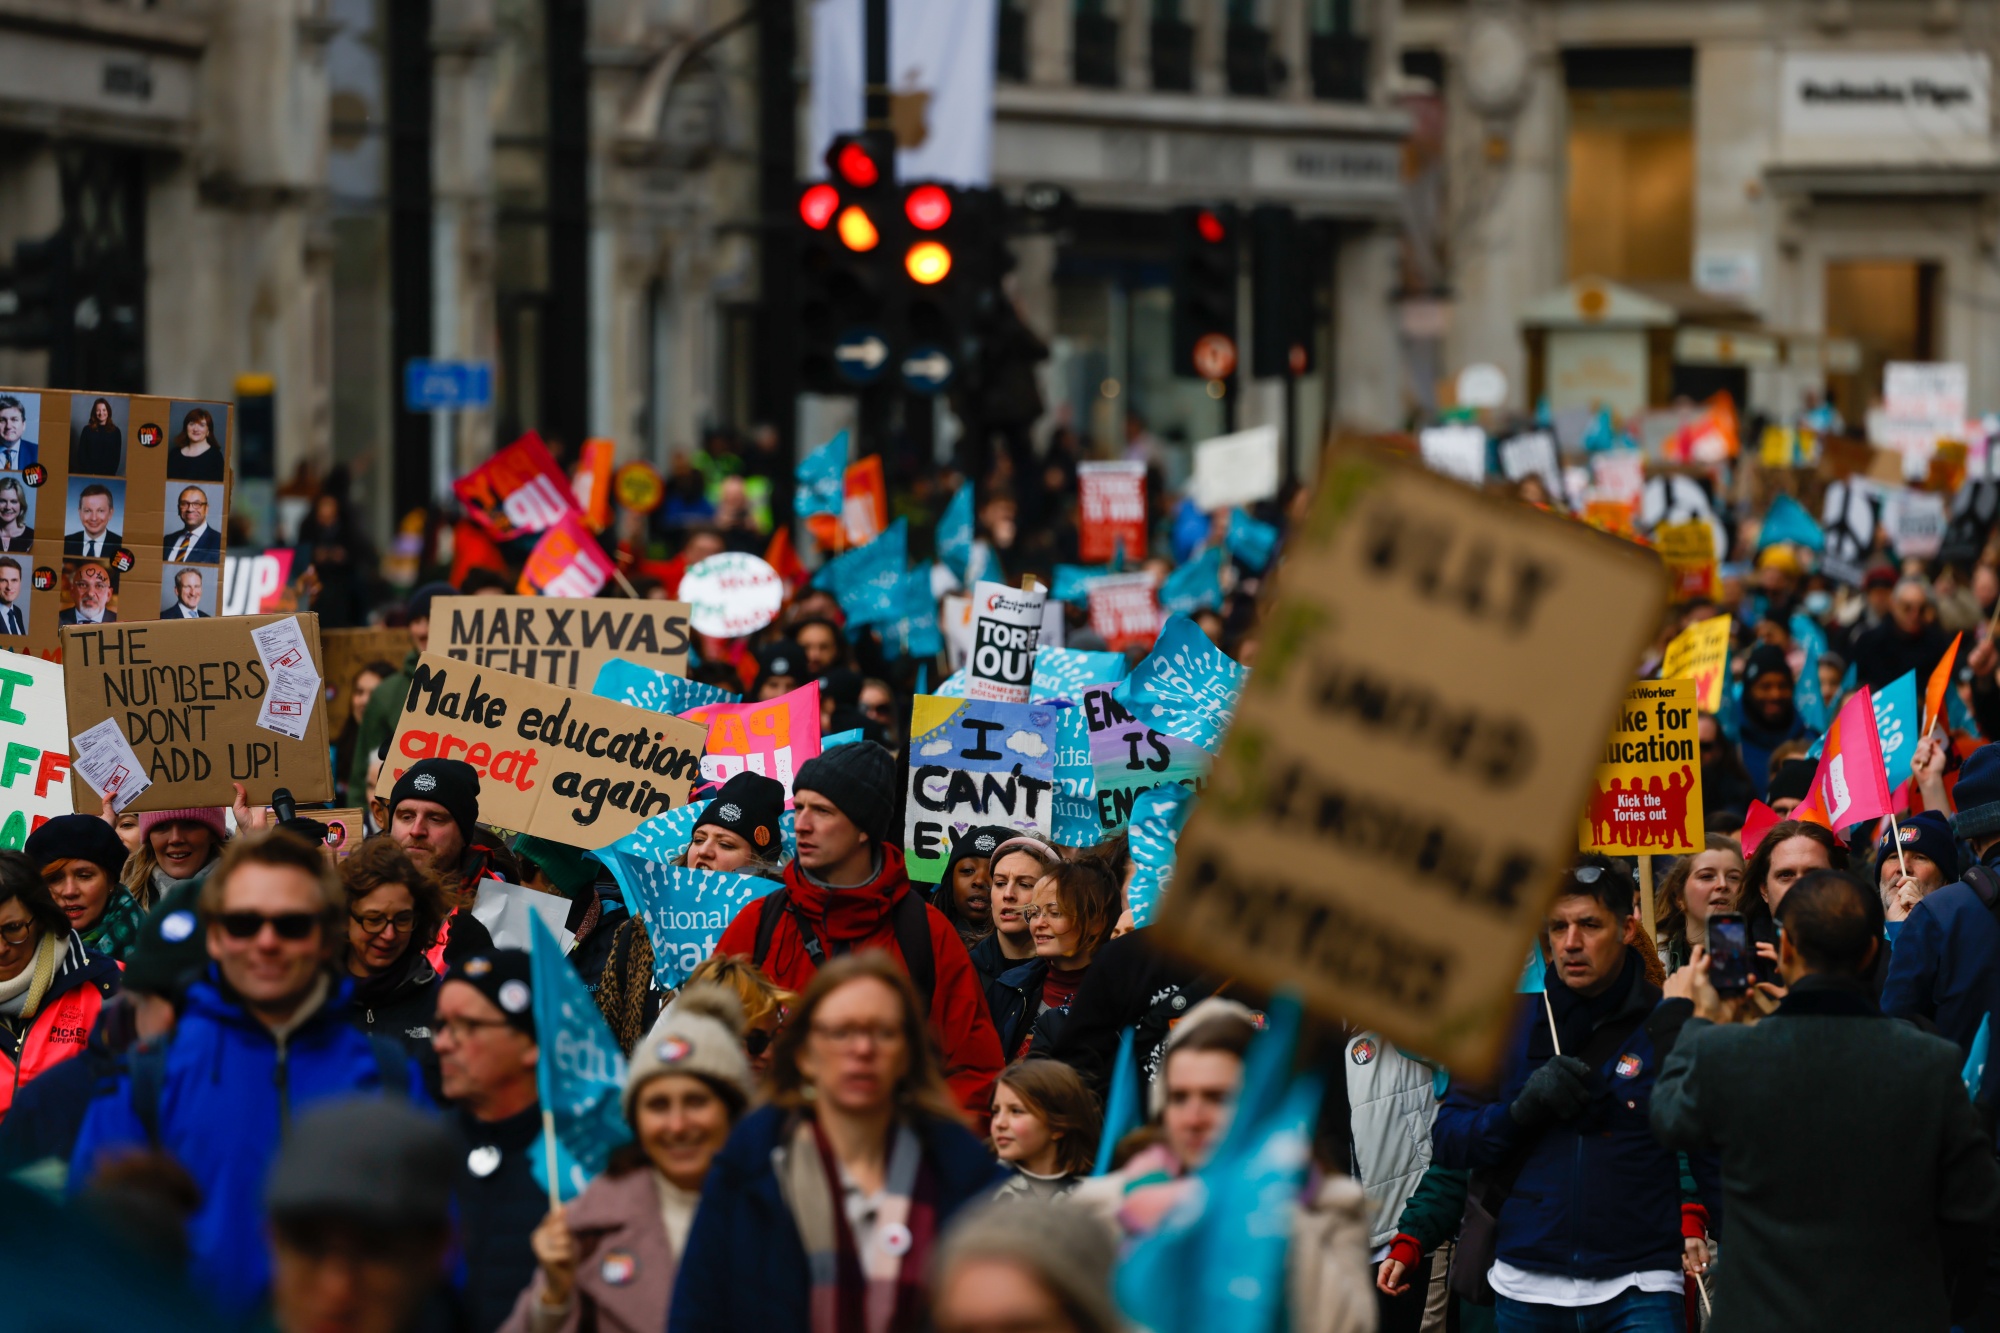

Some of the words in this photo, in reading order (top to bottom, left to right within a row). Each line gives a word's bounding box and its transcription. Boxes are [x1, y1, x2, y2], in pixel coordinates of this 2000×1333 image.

[70, 629, 151, 666] THE
[450, 608, 575, 646] MARX
[580, 610, 691, 656] WAS
[280, 657, 292, 667] FAIL
[103, 660, 266, 707] NUMBERS
[1637, 687, 1677, 699] Worker
[127, 704, 215, 746] DON'T
[406, 663, 507, 728] Make
[517, 697, 699, 781] education
[1655, 702, 1692, 731] for
[961, 718, 1004, 761] I
[1122, 731, 1171, 772] IS
[150, 747, 212, 783] ADD
[228, 741, 279, 779] UP!
[394, 729, 539, 791] great
[552, 770, 671, 826] again
[913, 763, 1053, 819] CAN'T
[1618, 794, 1641, 808] Kick
[1644, 793, 1661, 807] the
[1613, 808, 1646, 822] Tories
[1649, 808, 1667, 821] out
[48, 1035, 87, 1046] SUPERVISR
[50, 1026, 87, 1038] PICKET
